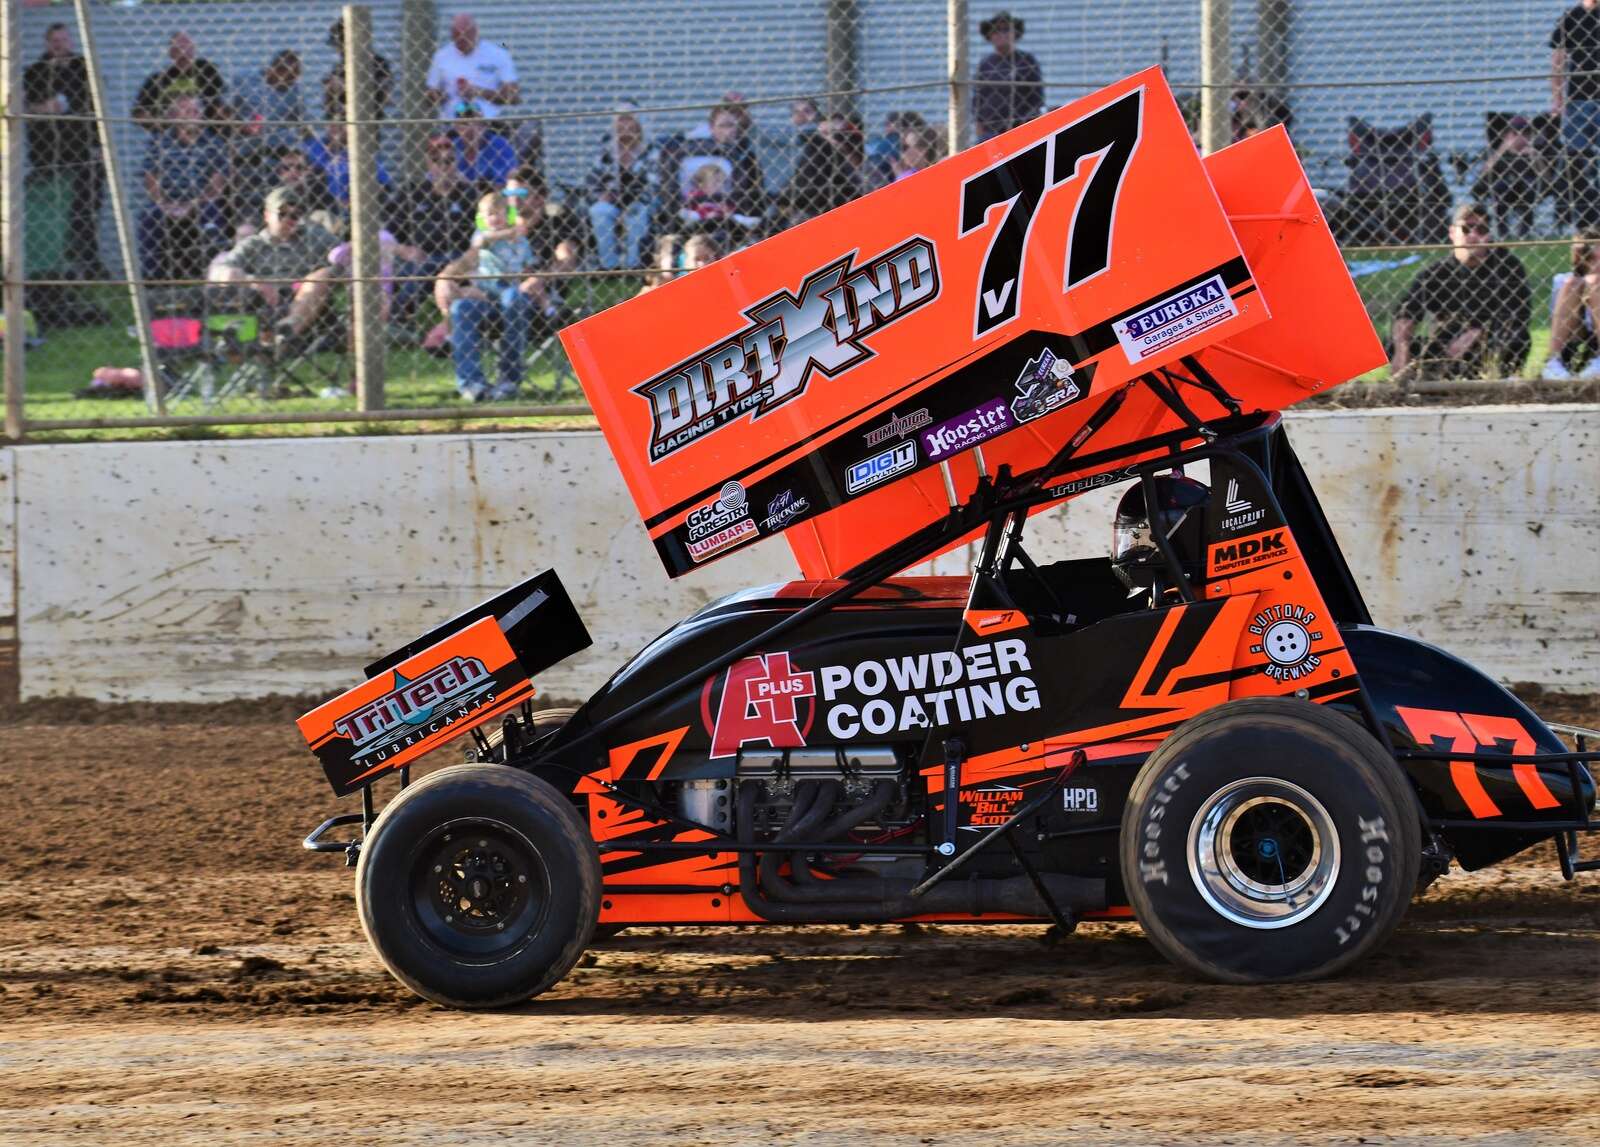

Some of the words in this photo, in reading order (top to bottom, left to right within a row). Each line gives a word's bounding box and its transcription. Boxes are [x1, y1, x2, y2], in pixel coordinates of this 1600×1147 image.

[1137, 285, 1222, 332] EUREKA
[1144, 321, 1184, 345] Garages
[1186, 317, 1194, 326] &
[1195, 303, 1226, 322] Sheds
[1045, 386, 1077, 407] SRA
[653, 418, 715, 457] RACING
[719, 384, 775, 424] TYRES
[926, 404, 1006, 457] Hoosier
[954, 432, 986, 450] RACING
[987, 421, 1008, 434] TIRE
[686, 500, 726, 529] G&C
[689, 502, 750, 541] FORESTRY
[762, 498, 806, 528] TRUCKING
[1222, 509, 1266, 529] LOCALPRINT
[694, 520, 754, 555] LUMBAR'S
[1214, 532, 1285, 565] MDK
[1214, 558, 1251, 573] COMPUTER
[1253, 548, 1289, 563] SERVICES
[1250, 604, 1315, 635] BUTTONS
[820, 638, 1033, 702] POWDER
[1265, 655, 1321, 681] BREWING
[758, 679, 805, 697] PLUS
[826, 676, 1042, 740] COATING
[365, 692, 496, 768] LUBRICANTS
[1063, 788, 1098, 808] HPD
